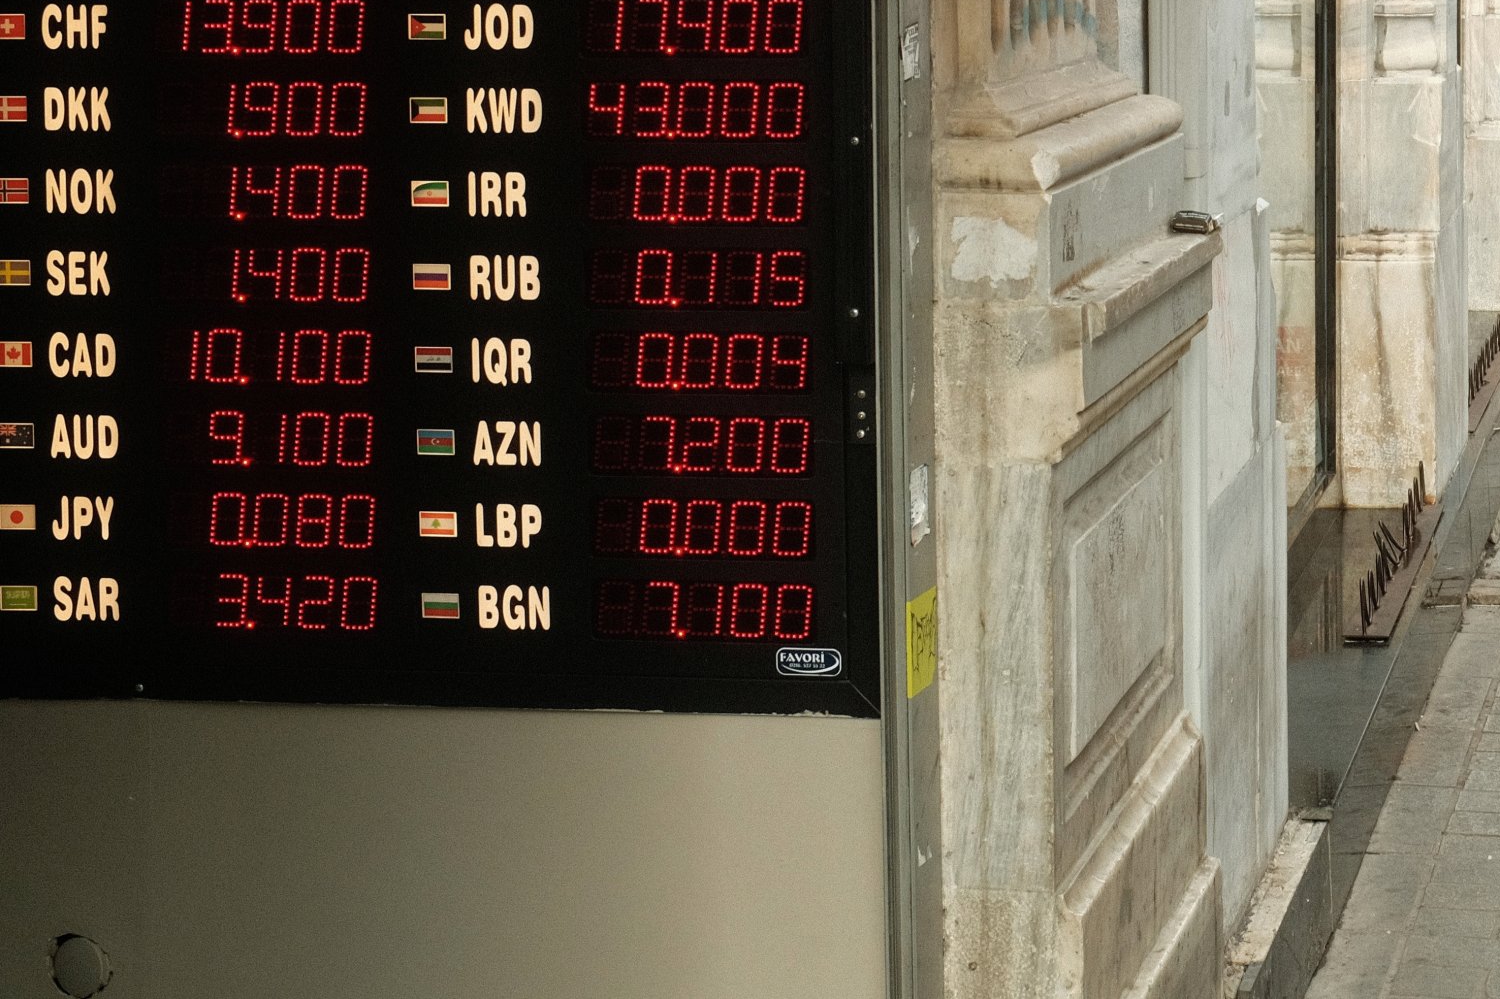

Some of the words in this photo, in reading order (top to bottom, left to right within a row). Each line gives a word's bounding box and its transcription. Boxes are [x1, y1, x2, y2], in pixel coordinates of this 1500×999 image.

[42, 4, 107, 50] CHF
[182, 0, 365, 55] 13.900
[464, 3, 534, 50] JOD
[44, 87, 111, 132] DKK
[227, 82, 367, 138] 1.900
[466, 87, 543, 133] KWD
[589, 82, 804, 138] 43.000
[46, 168, 116, 214] NOK
[229, 165, 369, 220] 1.400
[467, 171, 527, 217] IRR
[633, 165, 805, 222] 0.000
[46, 250, 111, 296] SEK
[231, 248, 371, 303] 1.400
[469, 254, 541, 301] RUB
[634, 249, 805, 306] 0.115
[48, 331, 116, 378] CAD
[190, 329, 372, 385] 10.100
[471, 337, 532, 387] IQR
[636, 332, 809, 390] 0.004
[50, 414, 119, 460] AUD
[209, 411, 374, 467] 9.100
[473, 420, 542, 467] AZN
[646, 416, 810, 473] 7.200
[52, 495, 114, 541] JPY
[209, 492, 376, 549] 0.080
[475, 502, 542, 549] LBP
[639, 499, 812, 557] 0.000
[53, 575, 120, 622] SAR
[216, 573, 378, 630] 3.420
[478, 584, 551, 631] BGN
[650, 582, 813, 639] 7.100
